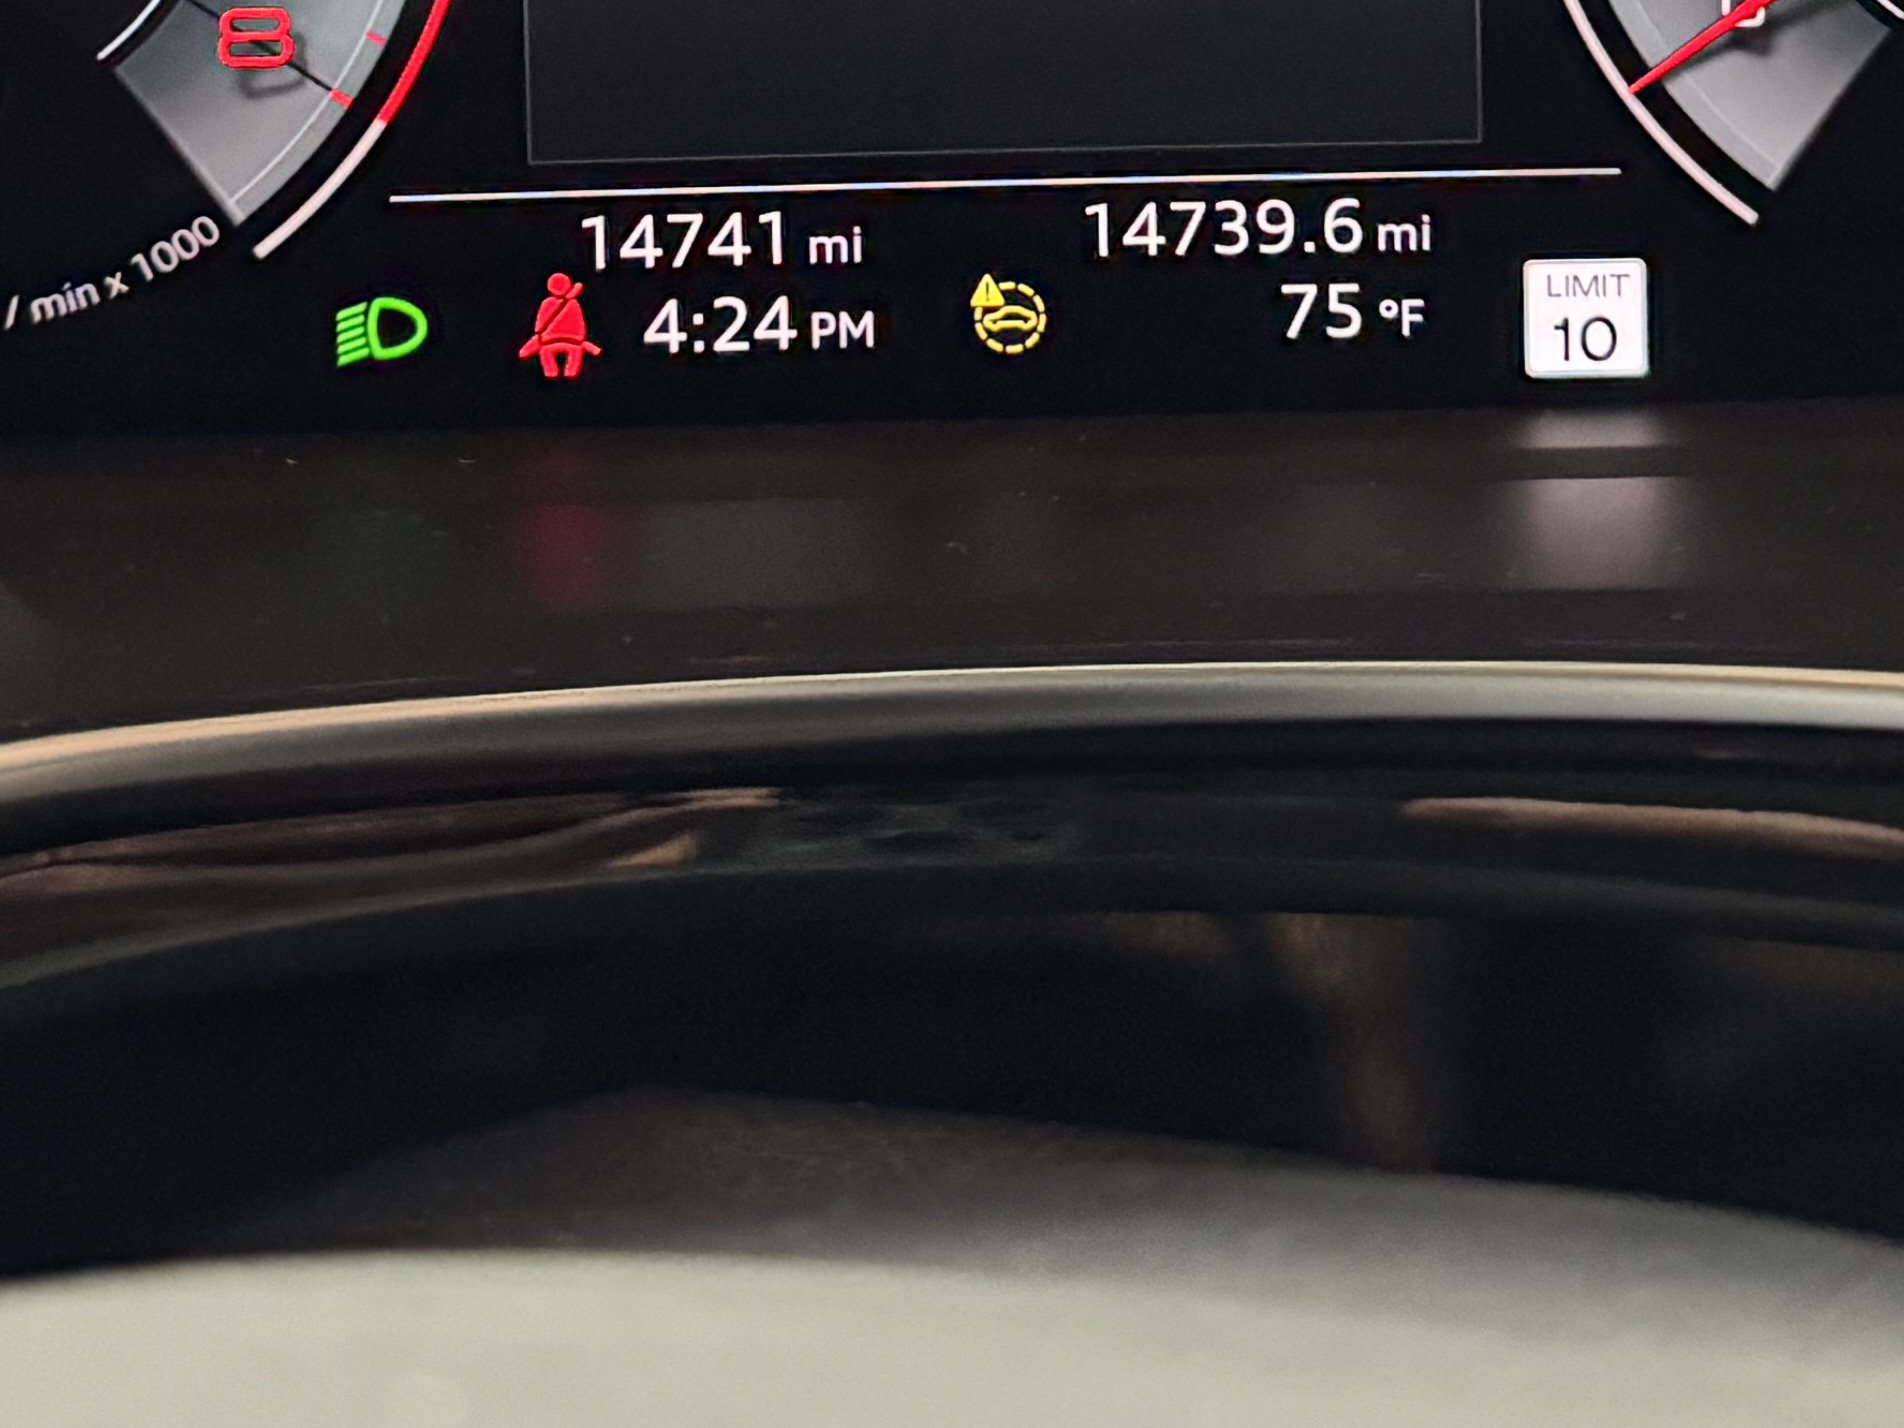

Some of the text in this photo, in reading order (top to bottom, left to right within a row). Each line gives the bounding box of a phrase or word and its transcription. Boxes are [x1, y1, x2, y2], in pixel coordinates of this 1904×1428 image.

[217, 6, 297, 71] 8
[580, 209, 863, 271] 14741 mi
[1083, 196, 1432, 258] 14739.6 mi
[28, 280, 102, 325] min
[102, 270, 130, 301] x
[129, 214, 221, 282] 1000
[1544, 271, 1632, 301] LIMIT
[642, 294, 876, 355] 4:24 PM
[1279, 281, 1363, 340] 75
[1552, 315, 1619, 363] 10
